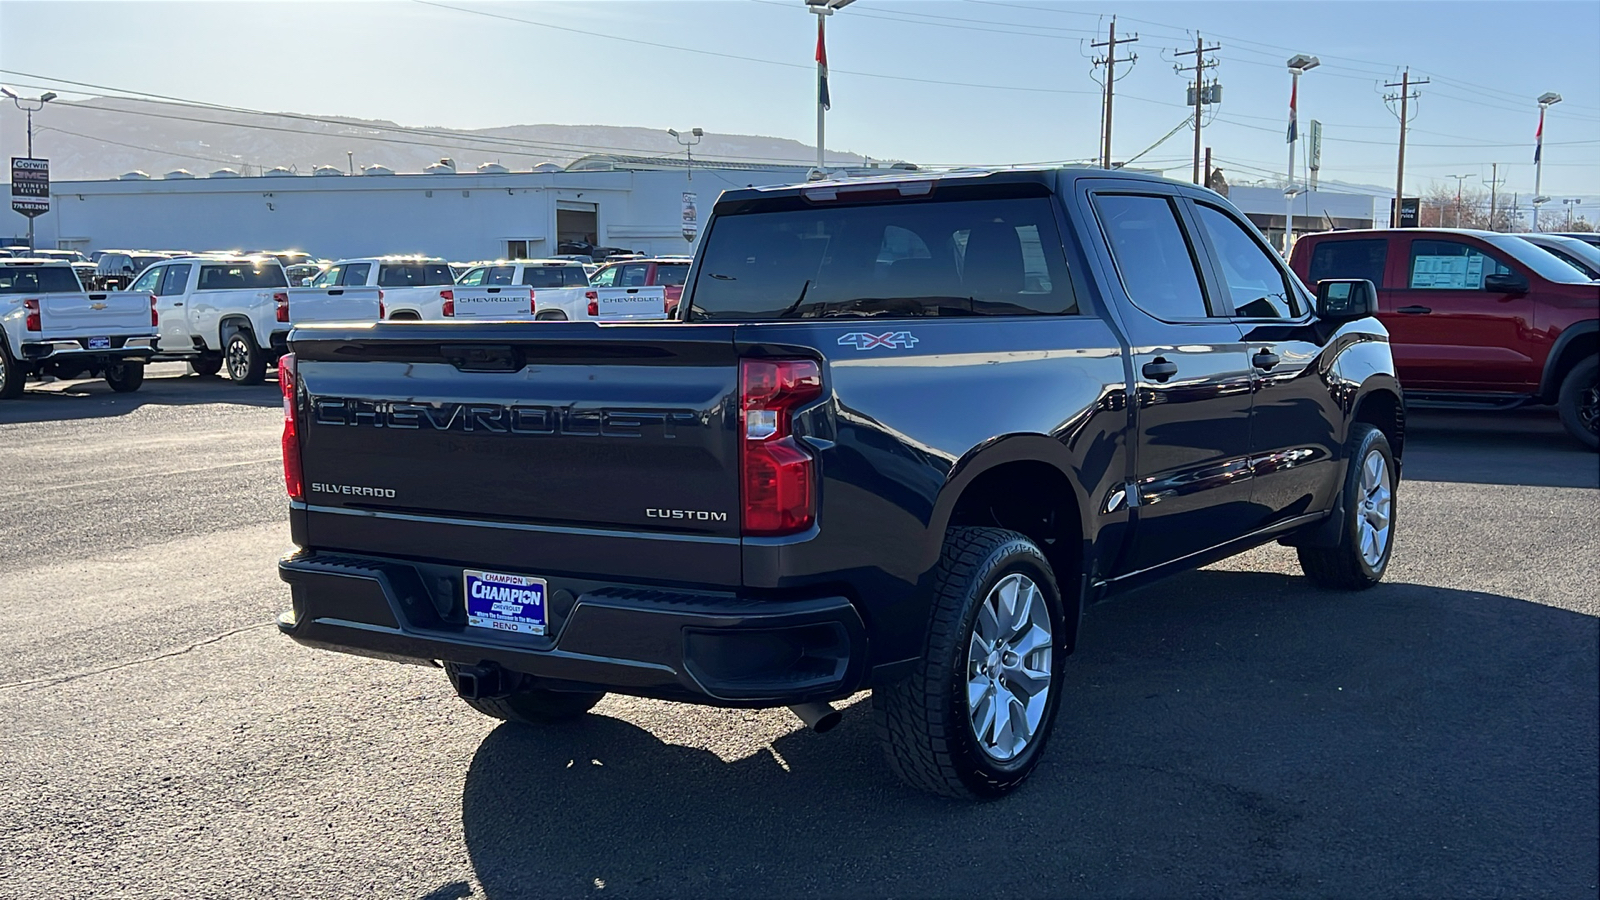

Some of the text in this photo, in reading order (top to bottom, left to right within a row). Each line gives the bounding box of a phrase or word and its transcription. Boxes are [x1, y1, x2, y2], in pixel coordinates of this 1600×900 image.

[15, 160, 49, 169] Corwin
[13, 171, 48, 180] GMC
[459, 296, 526, 304] CHEVROLET
[316, 400, 697, 438] CHEVROLET
[311, 482, 397, 499] SILVERADO
[645, 508, 727, 521] CUSTOM
[485, 574, 523, 585] CHAMPION
[471, 580, 541, 606] CHAMPION
[493, 603, 521, 612] CHEVROLET
[492, 621, 519, 631] RENO
